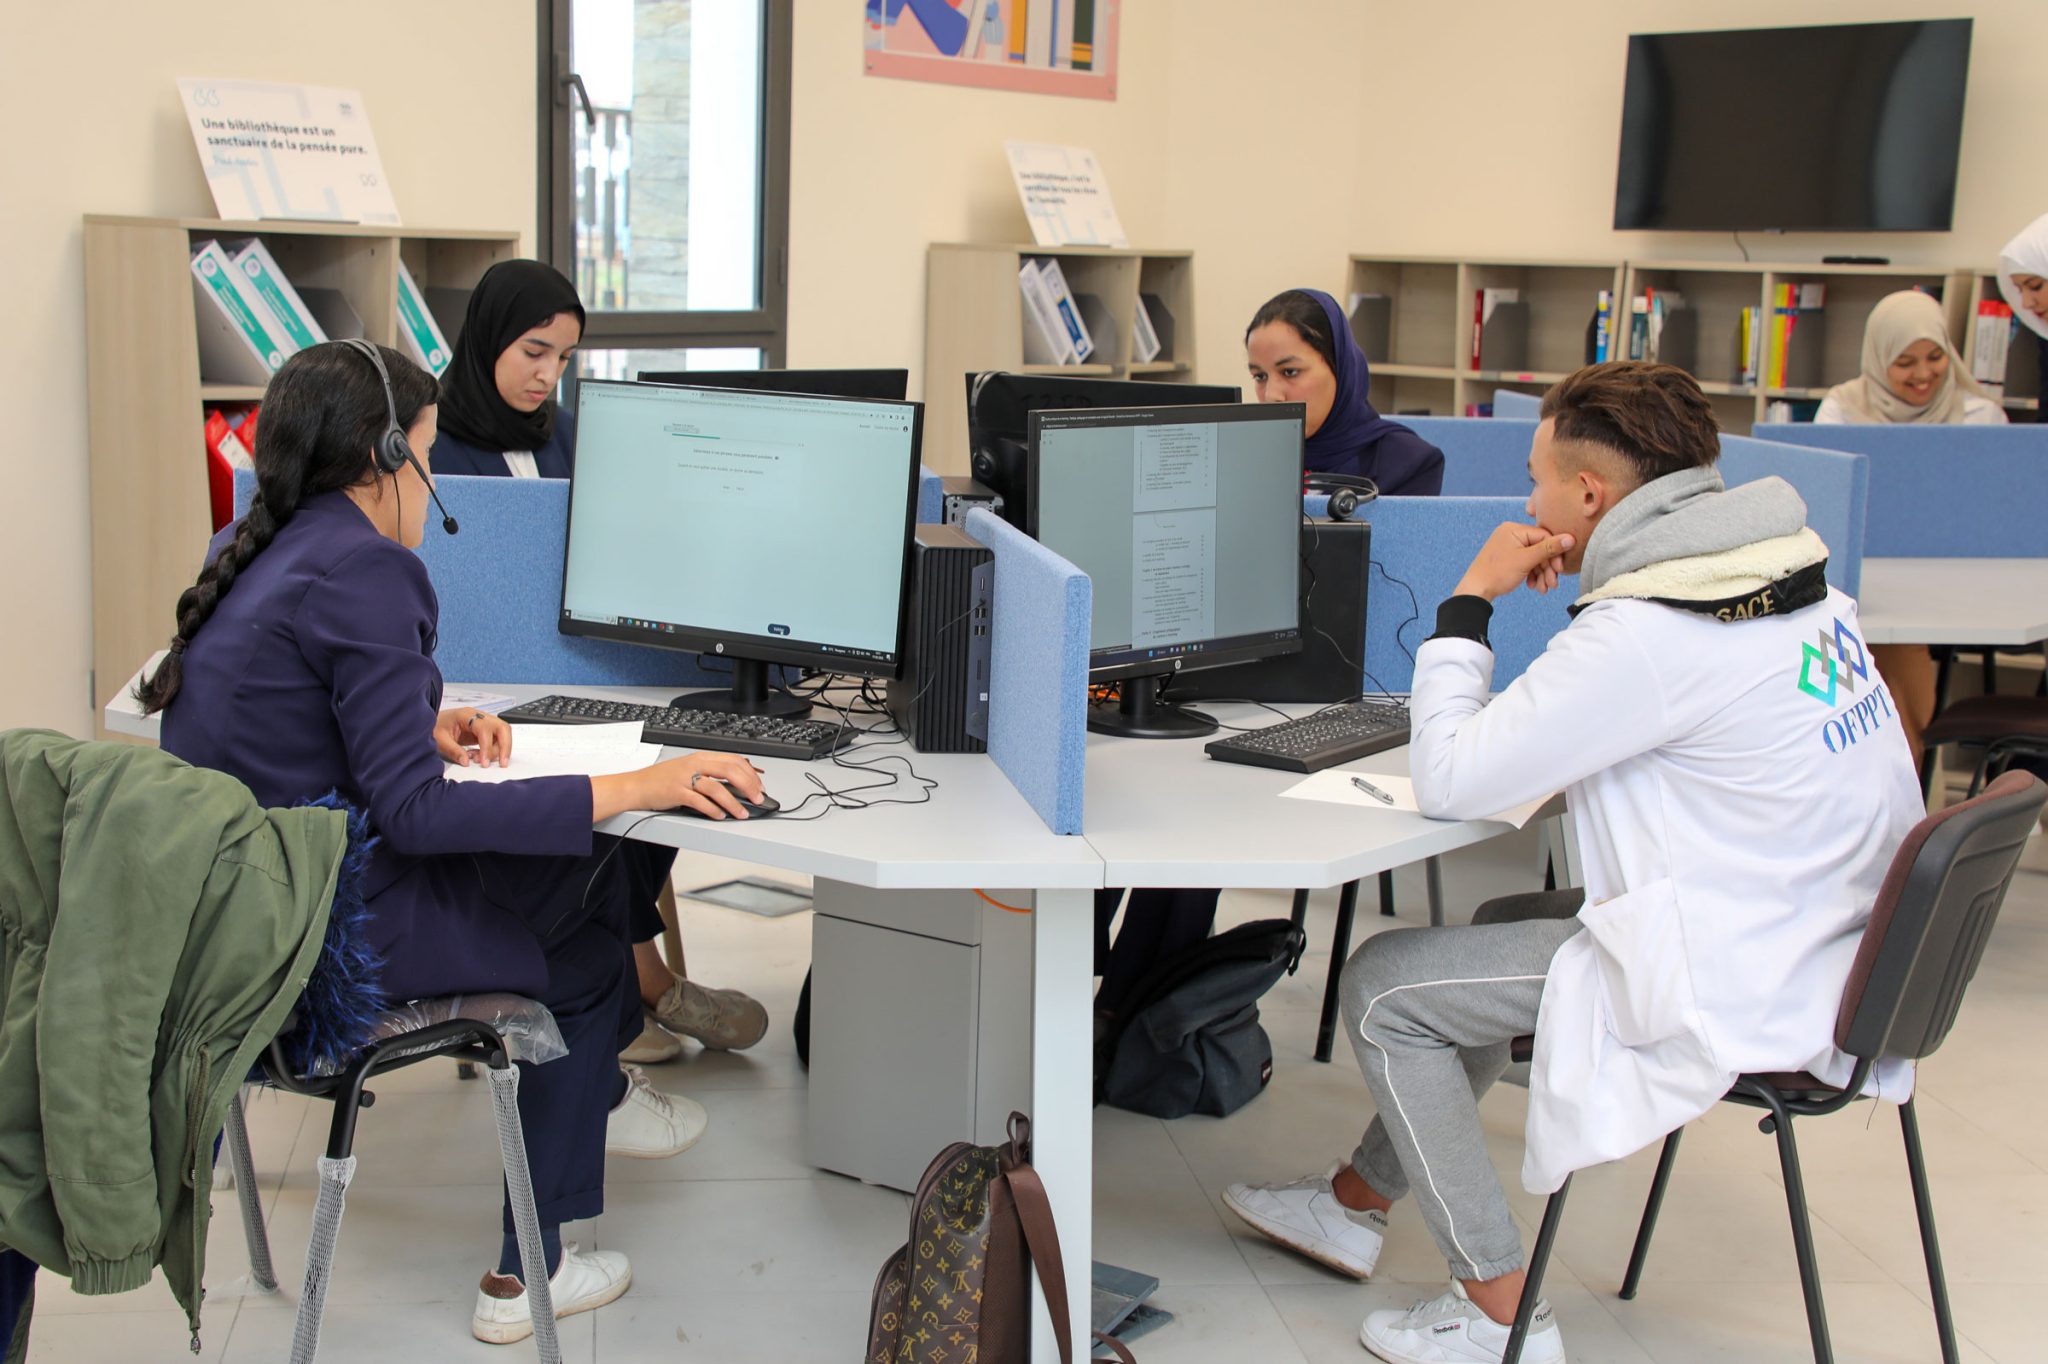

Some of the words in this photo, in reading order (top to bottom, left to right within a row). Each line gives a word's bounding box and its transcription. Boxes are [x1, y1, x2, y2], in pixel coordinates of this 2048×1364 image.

[201, 118, 225, 130] Une
[228, 119, 300, 136] bibliothèque
[302, 126, 319, 136] est
[321, 128, 336, 137] un
[207, 135, 268, 148] sanctuaire
[270, 139, 284, 150] de
[286, 139, 297, 151] la
[299, 141, 337, 155] pensée
[340, 145, 368, 156] pure.
[1822, 684, 1892, 754] OFPPT
